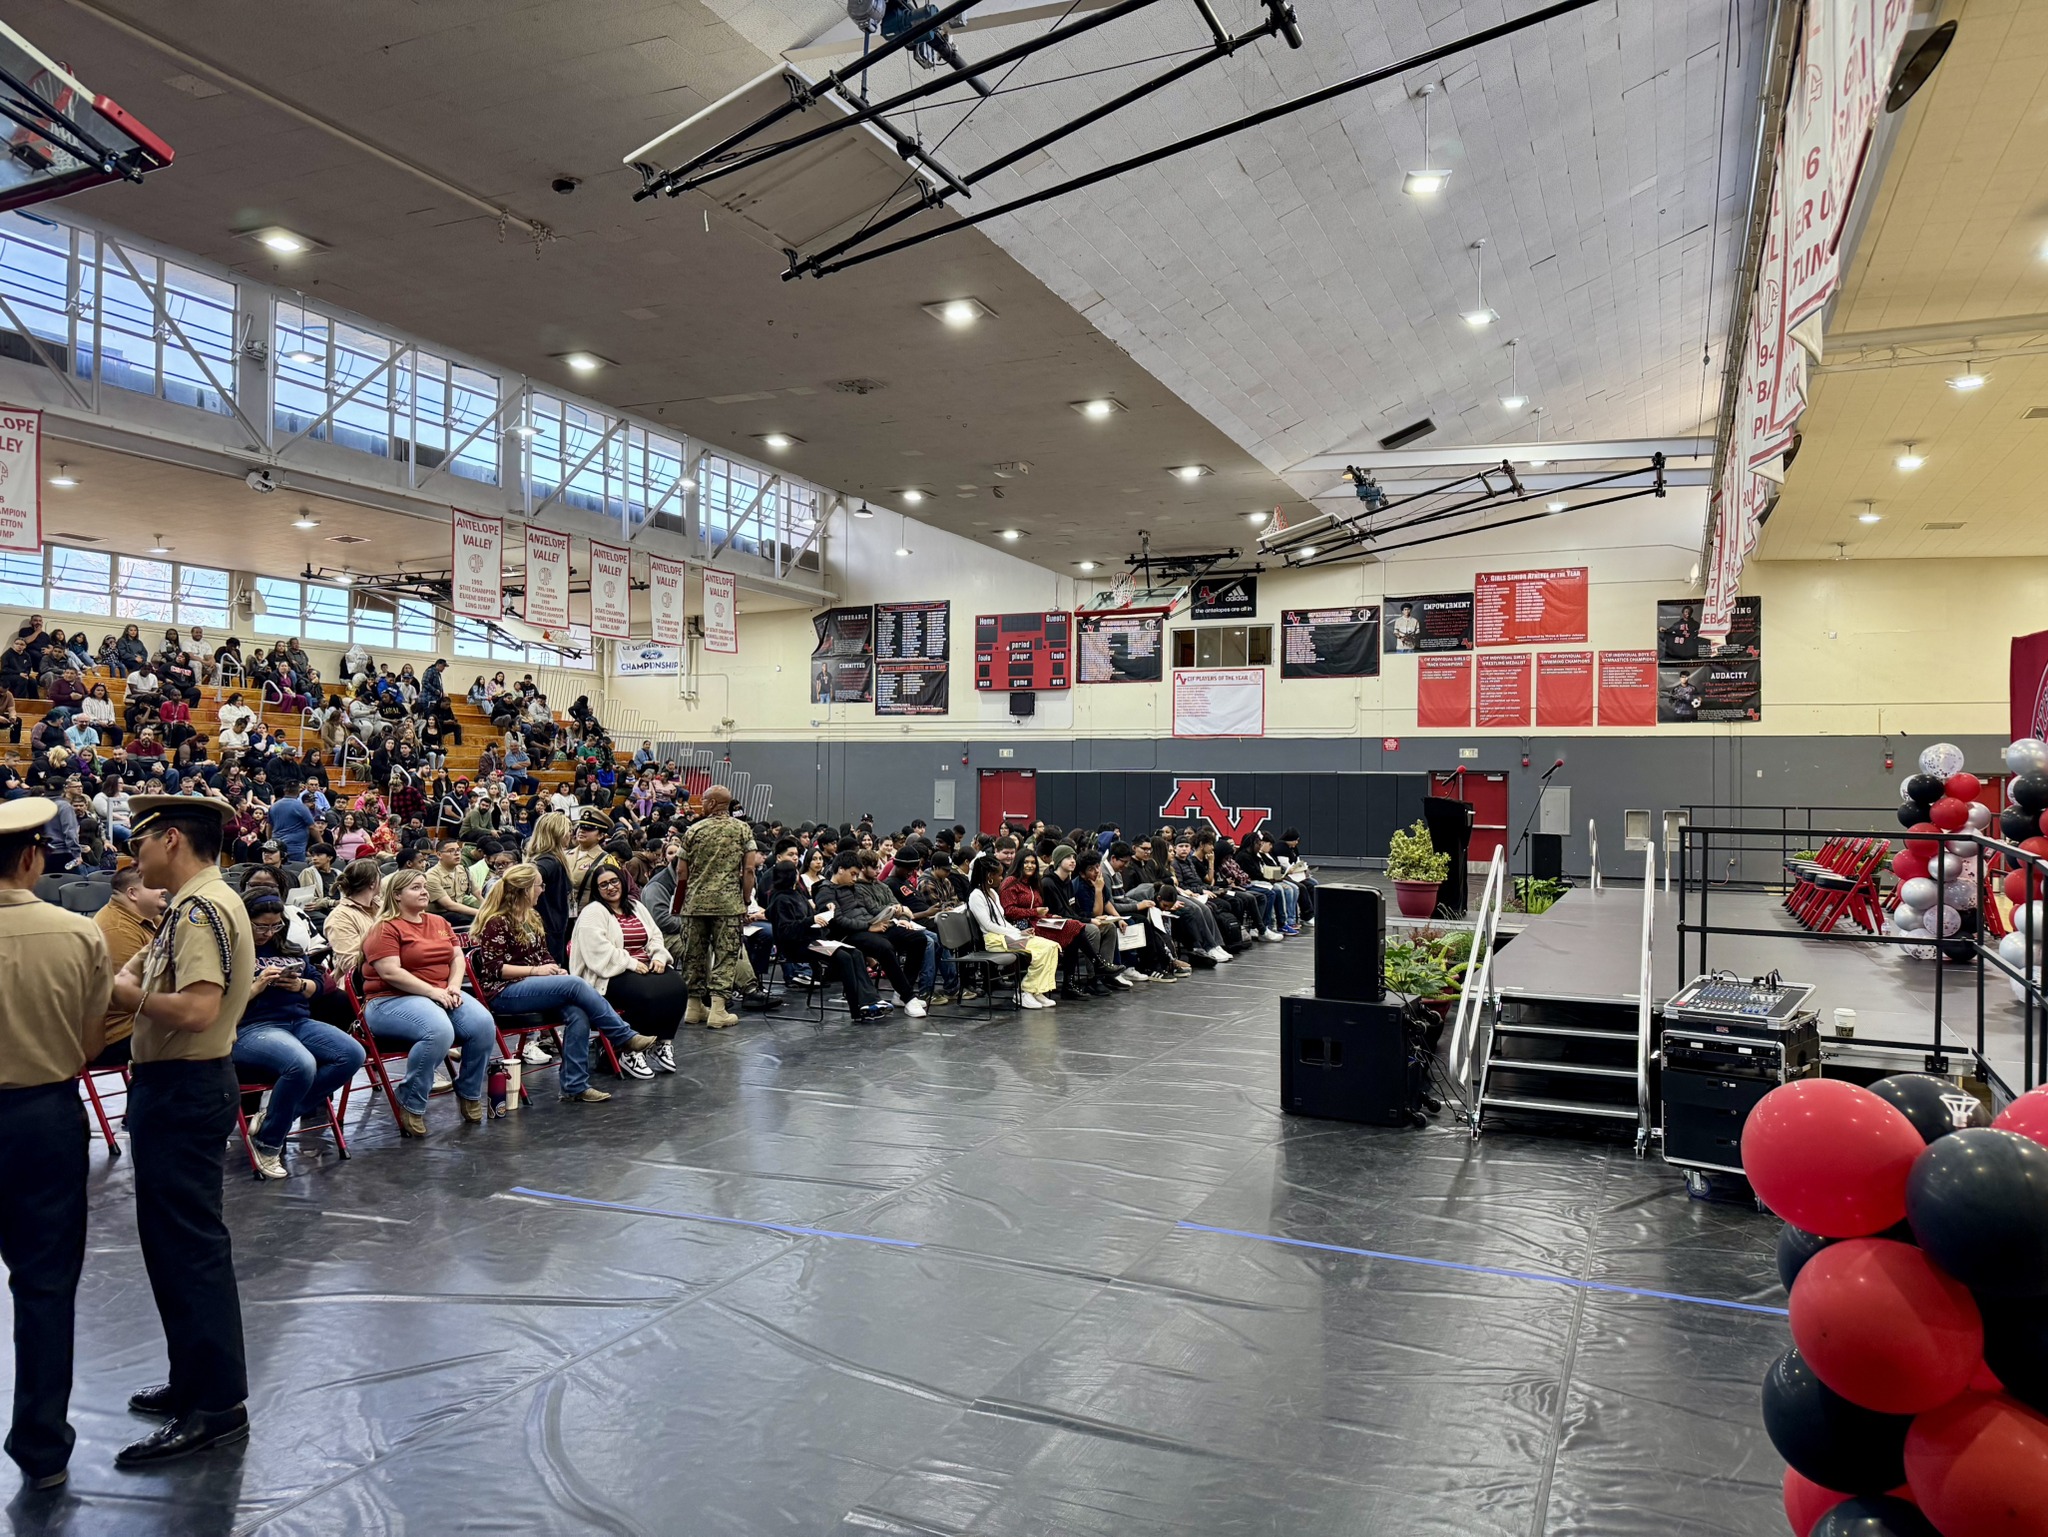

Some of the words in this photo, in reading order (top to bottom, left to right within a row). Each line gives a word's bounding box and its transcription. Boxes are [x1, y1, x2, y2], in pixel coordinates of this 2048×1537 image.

[0, 507, 26, 518] MPION
[456, 517, 499, 536] ANTELOPE
[463, 534, 492, 550] VALLEY
[529, 533, 566, 549] ANTELOPE
[533, 549, 560, 563] VALLEY
[593, 548, 627, 564] ANTELOPE
[598, 564, 622, 577] VALLEY
[652, 561, 682, 576] ANTELOPE
[657, 576, 678, 588] VALLEY
[705, 574, 733, 586] ANTELOPE
[710, 587, 729, 598] VALLEY
[1424, 602, 1470, 610] EMPOWERMENT
[1012, 641, 1029, 650] period
[1160, 778, 1271, 848] AV
